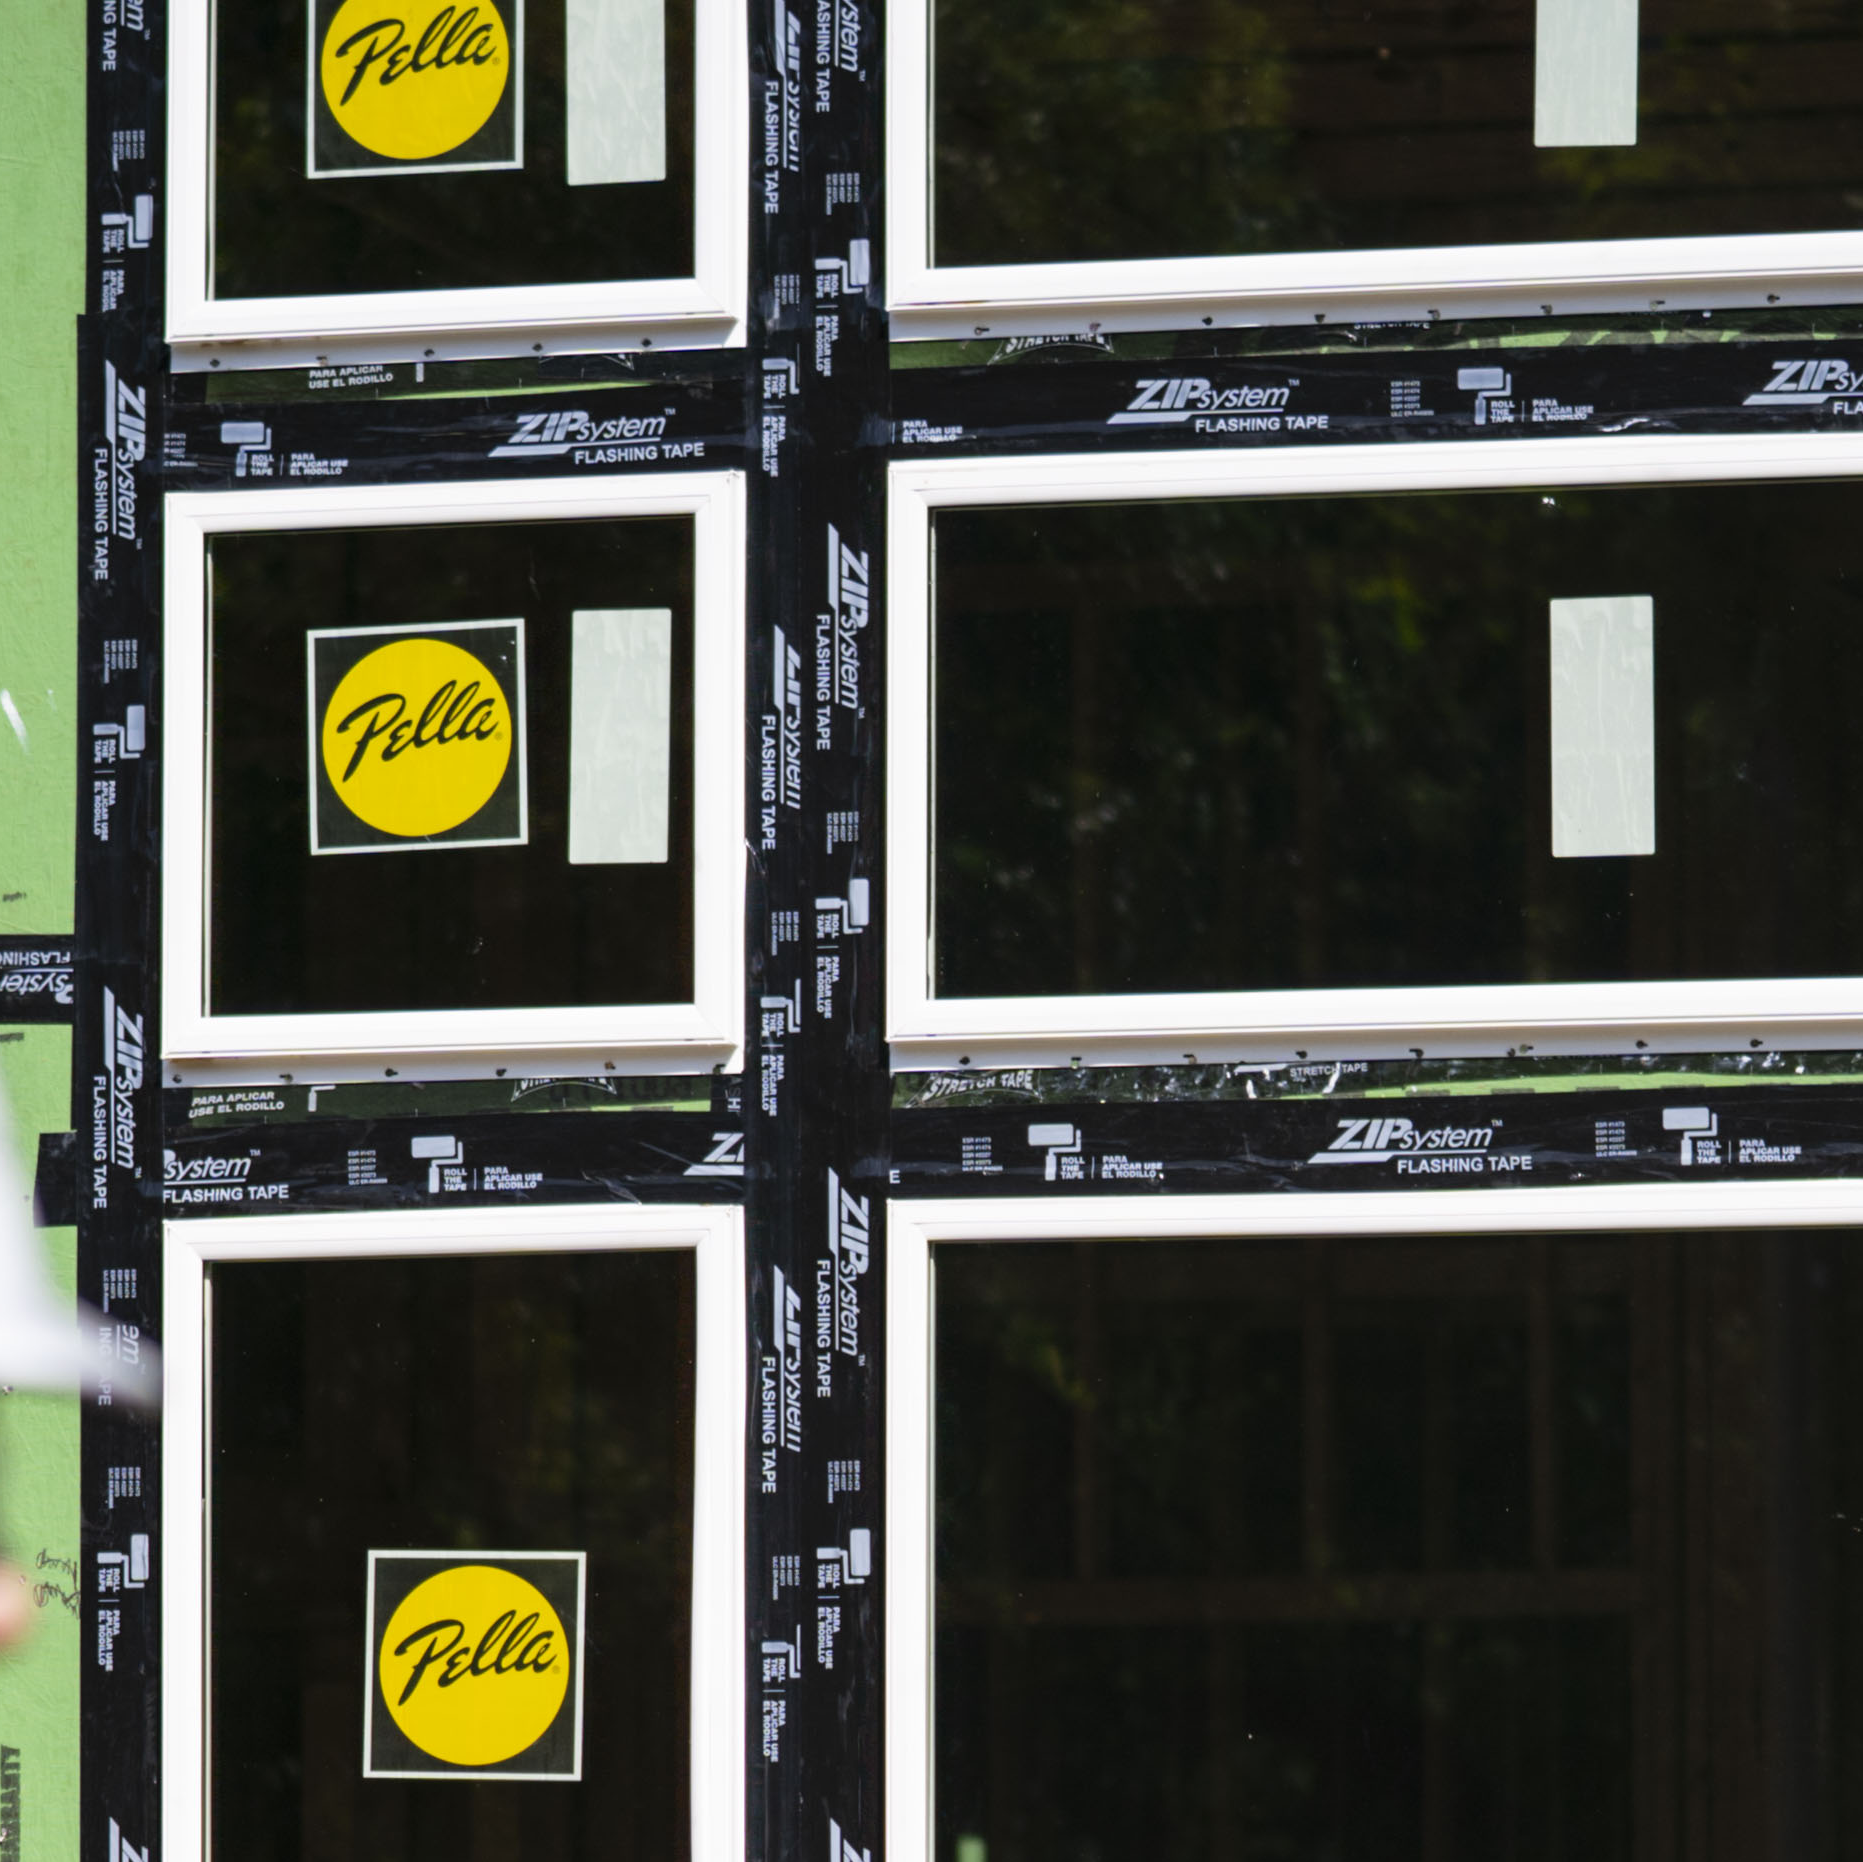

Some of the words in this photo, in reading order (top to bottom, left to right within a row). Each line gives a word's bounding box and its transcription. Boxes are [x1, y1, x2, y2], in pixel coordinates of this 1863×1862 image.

[337, 8, 497, 107] Pella
[1195, 417, 1281, 433] FLASHING
[1285, 415, 1328, 429] TAPE
[575, 446, 659, 464] FLASHING
[662, 442, 704, 458] TAPE
[95, 449, 108, 532] FLASHING
[95, 537, 108, 580] TAPE
[337, 680, 499, 783] Pella
[1398, 1157, 1483, 1174] FLASHING
[1488, 1155, 1532, 1171] TAPE
[162, 1186, 244, 1204] FLASHING
[248, 1185, 289, 1200] TAPE
[394, 1609, 557, 1706] Pella
